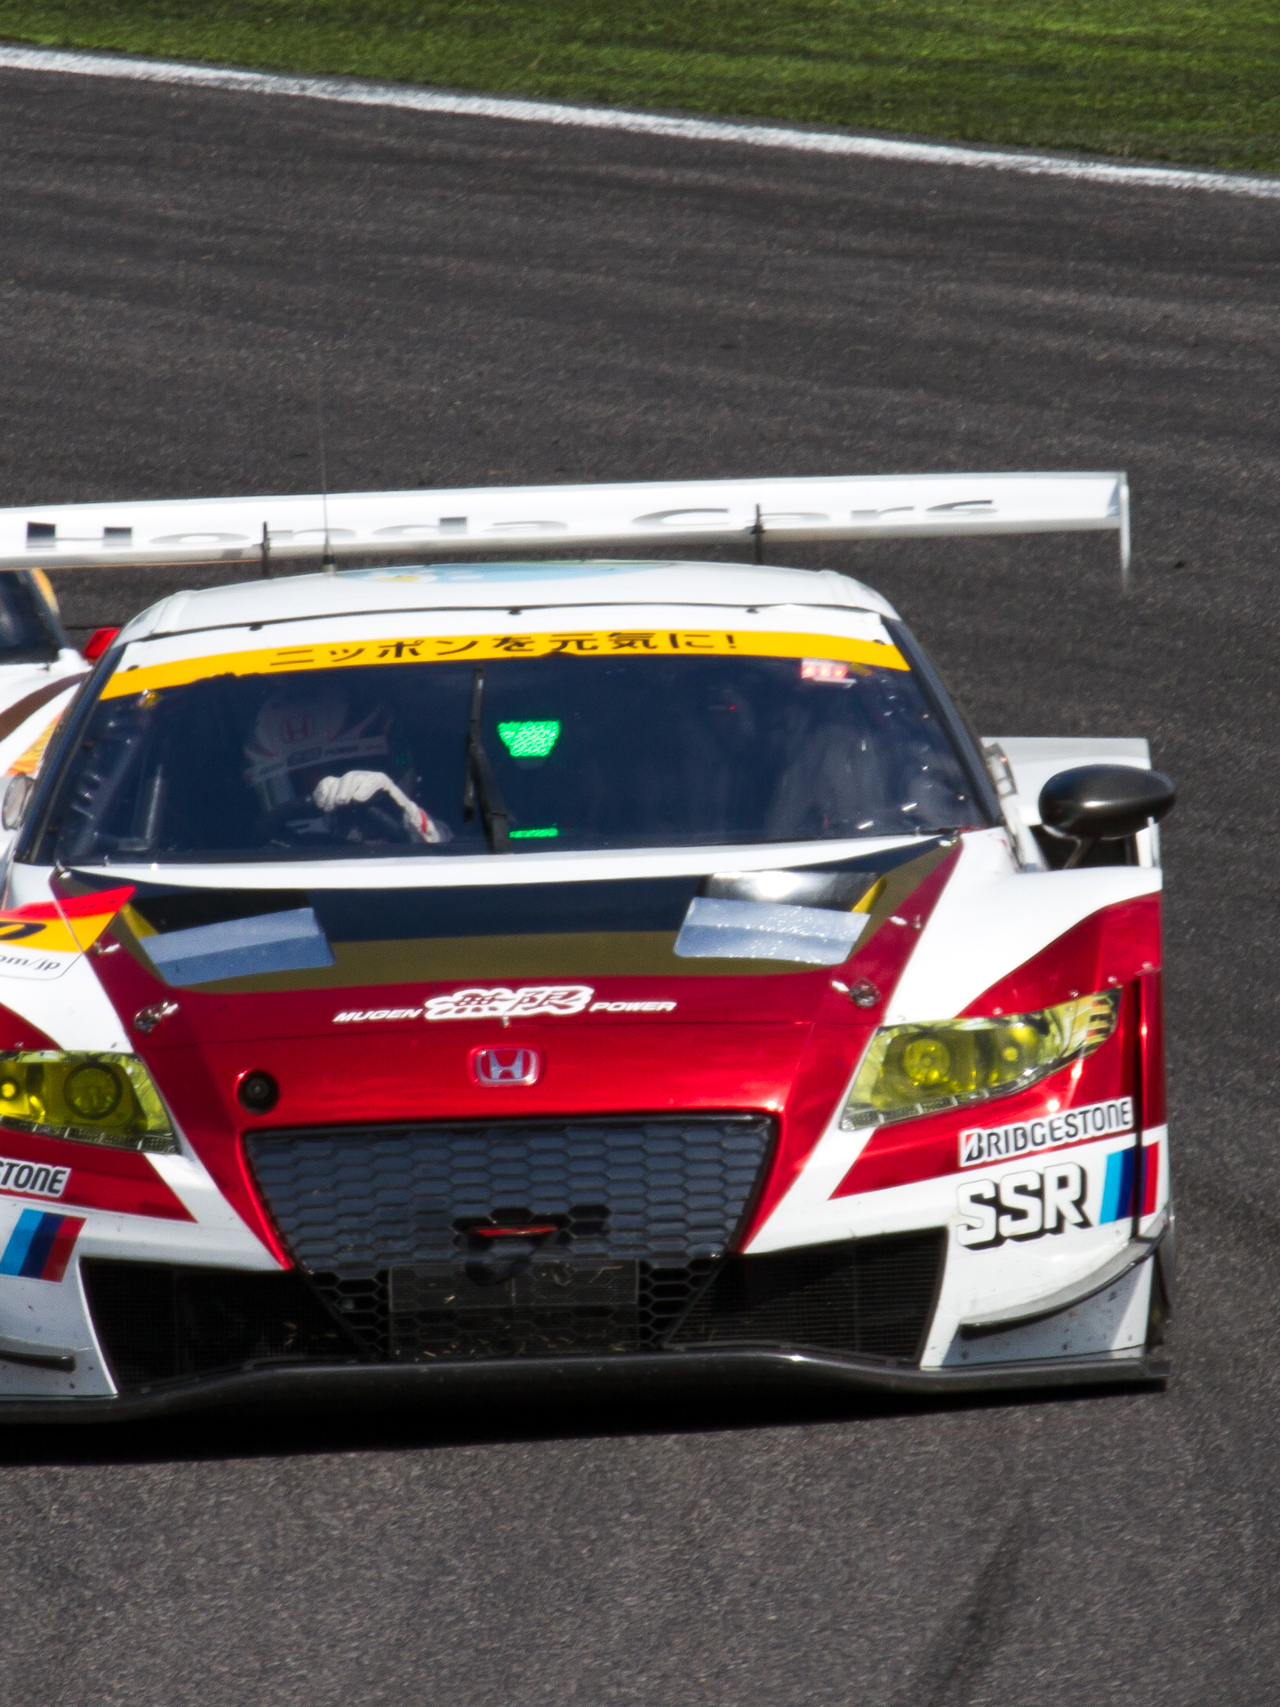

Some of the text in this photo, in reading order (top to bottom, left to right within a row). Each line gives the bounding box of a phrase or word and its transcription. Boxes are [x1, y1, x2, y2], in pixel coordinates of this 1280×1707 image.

[333, 1008, 423, 1022] MUGEN
[589, 1001, 677, 1013] POWER
[965, 1100, 1130, 1162] BRIDGESTONE
[957, 1162, 1093, 1251] SSR
